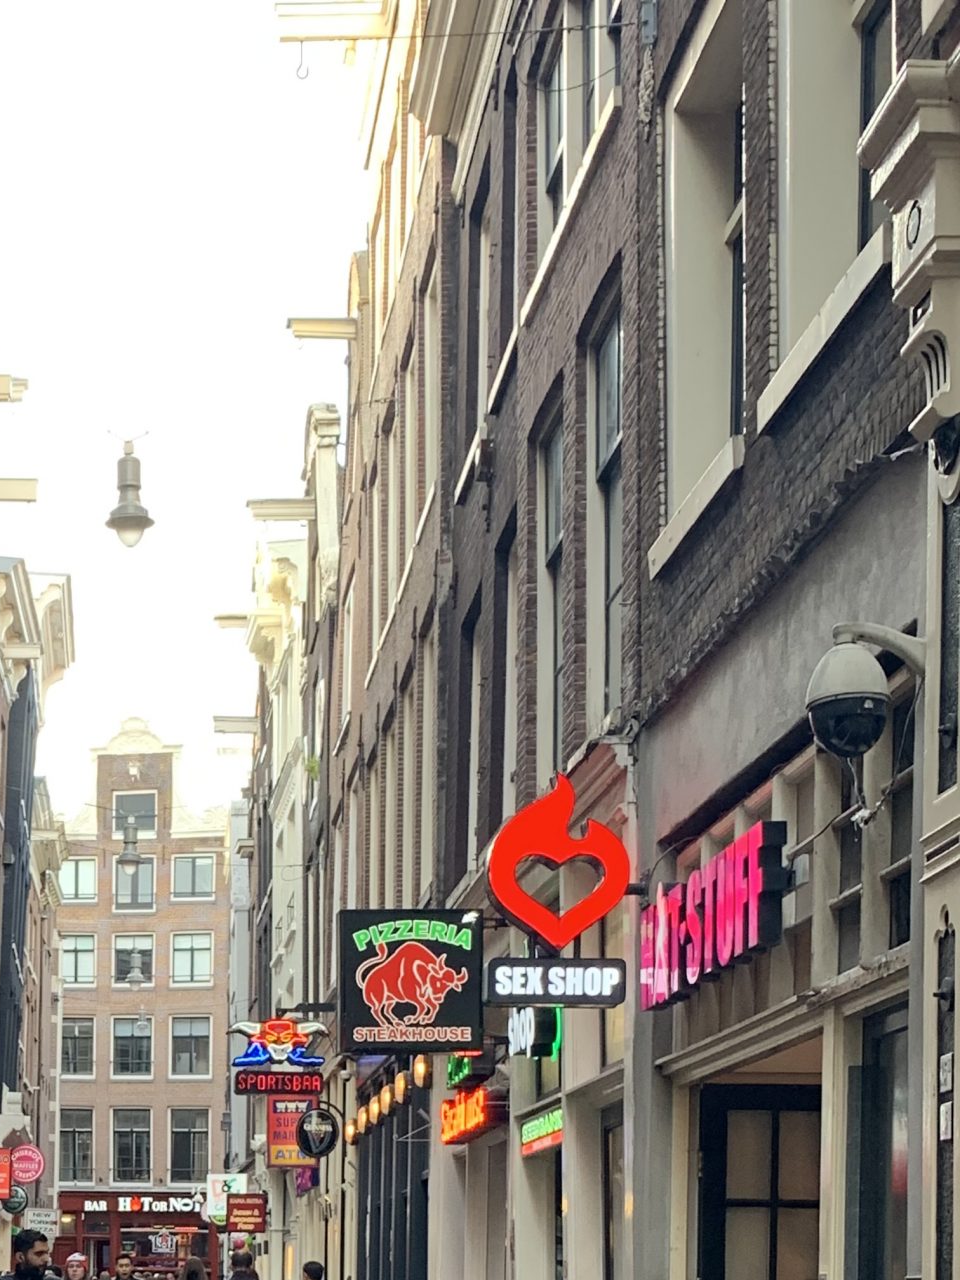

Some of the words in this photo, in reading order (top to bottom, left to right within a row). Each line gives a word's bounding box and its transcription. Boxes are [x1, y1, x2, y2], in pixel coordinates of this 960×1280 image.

[352, 919, 473, 952] PIZZERIA
[495, 966, 543, 996] SEX
[548, 967, 620, 997] SHOP
[352, 1026, 472, 1042] STEAKHOUSE
[84, 1200, 107, 1211] BAR
[152, 1202, 168, 1211] OR
